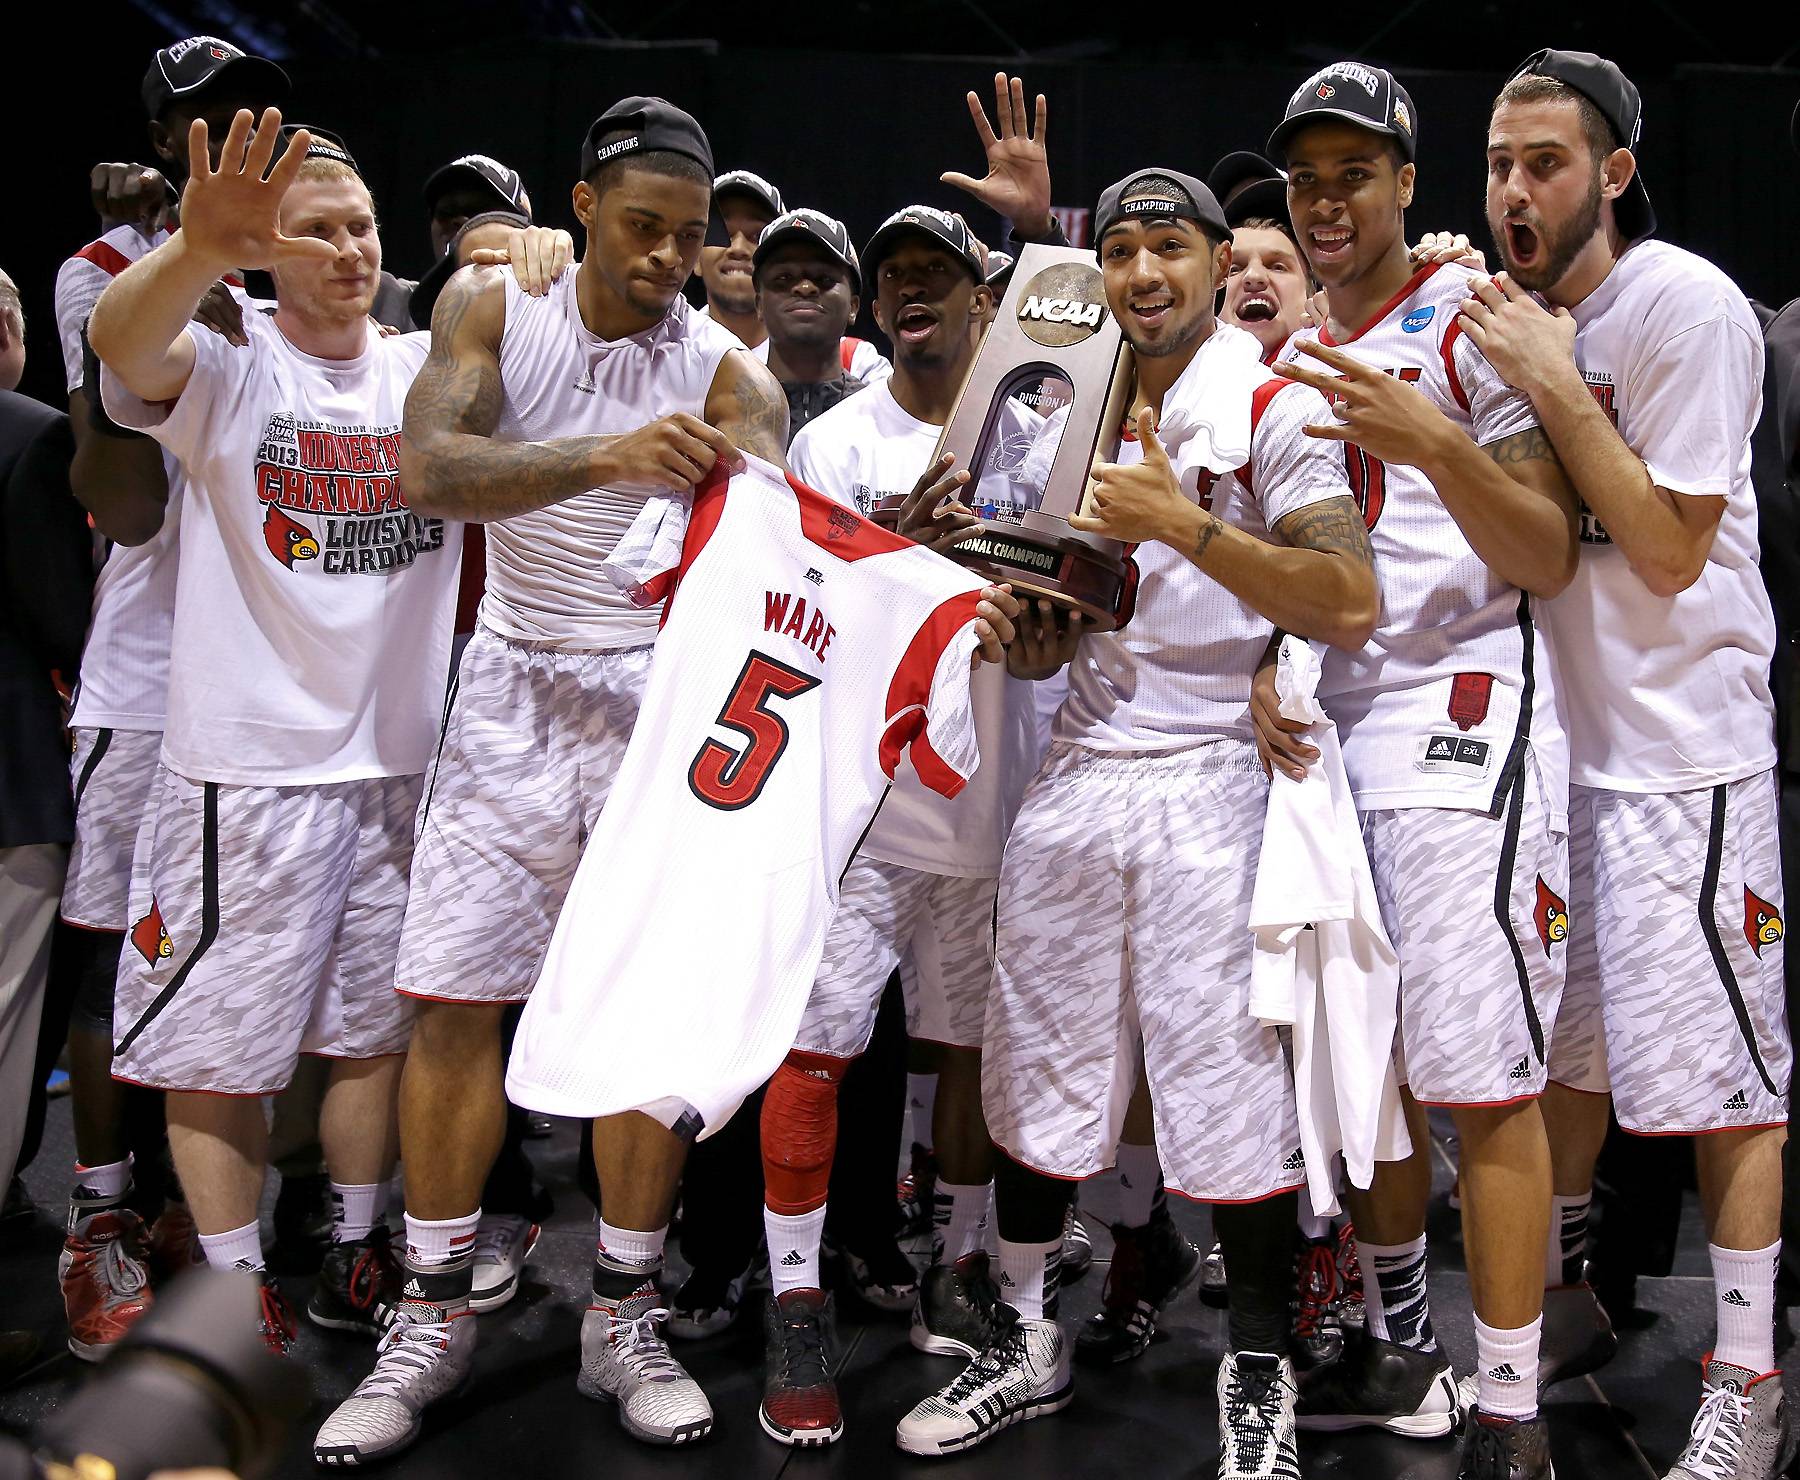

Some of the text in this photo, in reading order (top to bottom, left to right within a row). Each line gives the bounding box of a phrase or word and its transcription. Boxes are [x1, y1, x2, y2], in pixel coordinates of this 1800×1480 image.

[307, 144, 348, 160] AMPIONS
[597, 136, 639, 160] CHAMPIONS
[1125, 200, 1175, 213] CHAMPIONS
[1019, 295, 1103, 331] NCAA
[1582, 370, 1612, 382] ETBALL
[1019, 392, 1058, 408] DIVISION
[257, 442, 298, 466] 2013
[255, 461, 411, 517] CHAMPI
[322, 527, 445, 575] CARDINLS
[954, 537, 1054, 569] IONAL CHAMPION
[805, 572, 825, 585] EAST
[764, 590, 836, 664] WARE
[688, 648, 822, 811] 5
[1429, 745, 1480, 757] adidas 2XL
[1722, 1101, 1749, 1110] adidas
[780, 1258, 807, 1266] adidas
[1488, 1370, 1521, 1382] adidas
